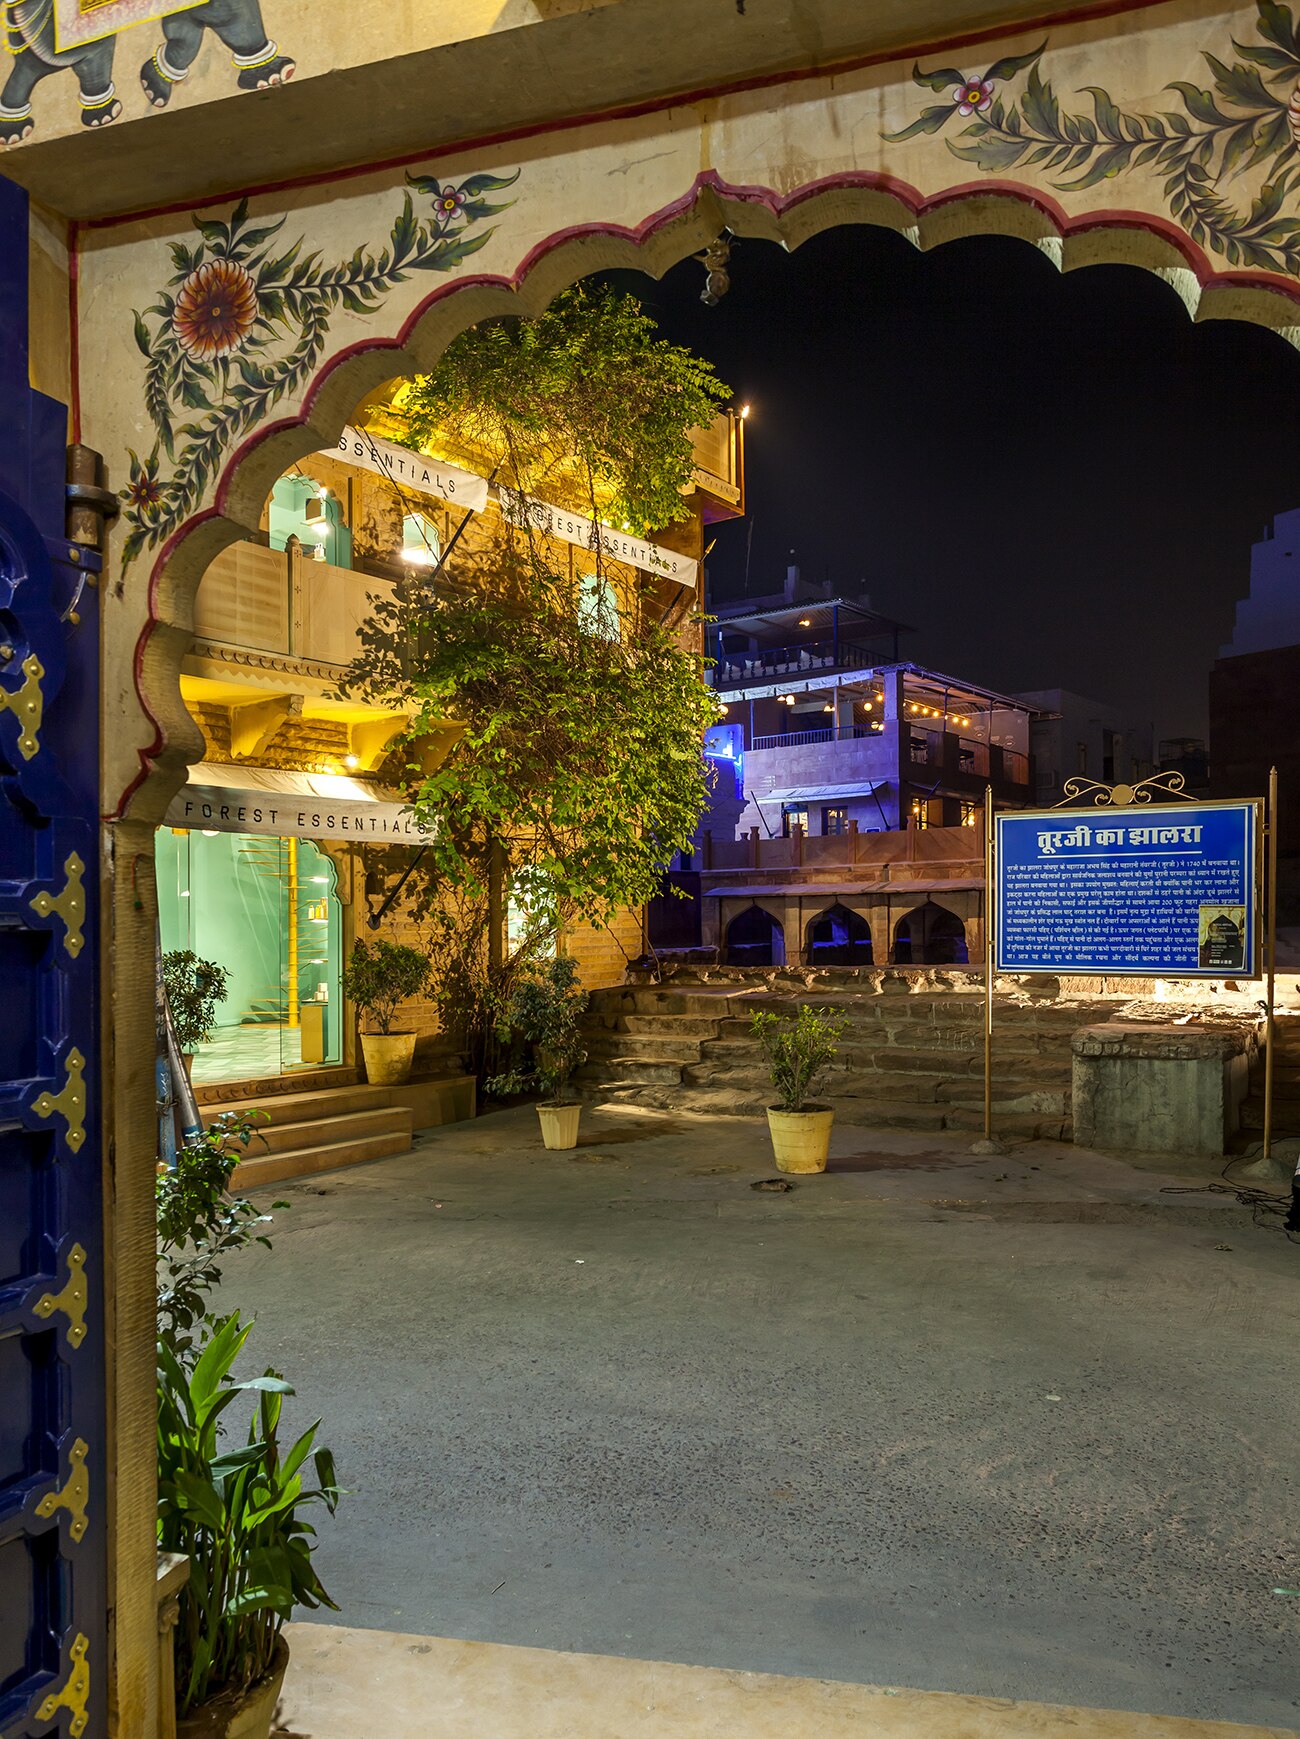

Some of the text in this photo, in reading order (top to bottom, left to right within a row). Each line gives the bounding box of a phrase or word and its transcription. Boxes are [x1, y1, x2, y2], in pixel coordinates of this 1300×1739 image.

[185, 802, 426, 834] FOREST ESSENTIALS
[1037, 825, 1203, 854] तूरजी का झालरा
